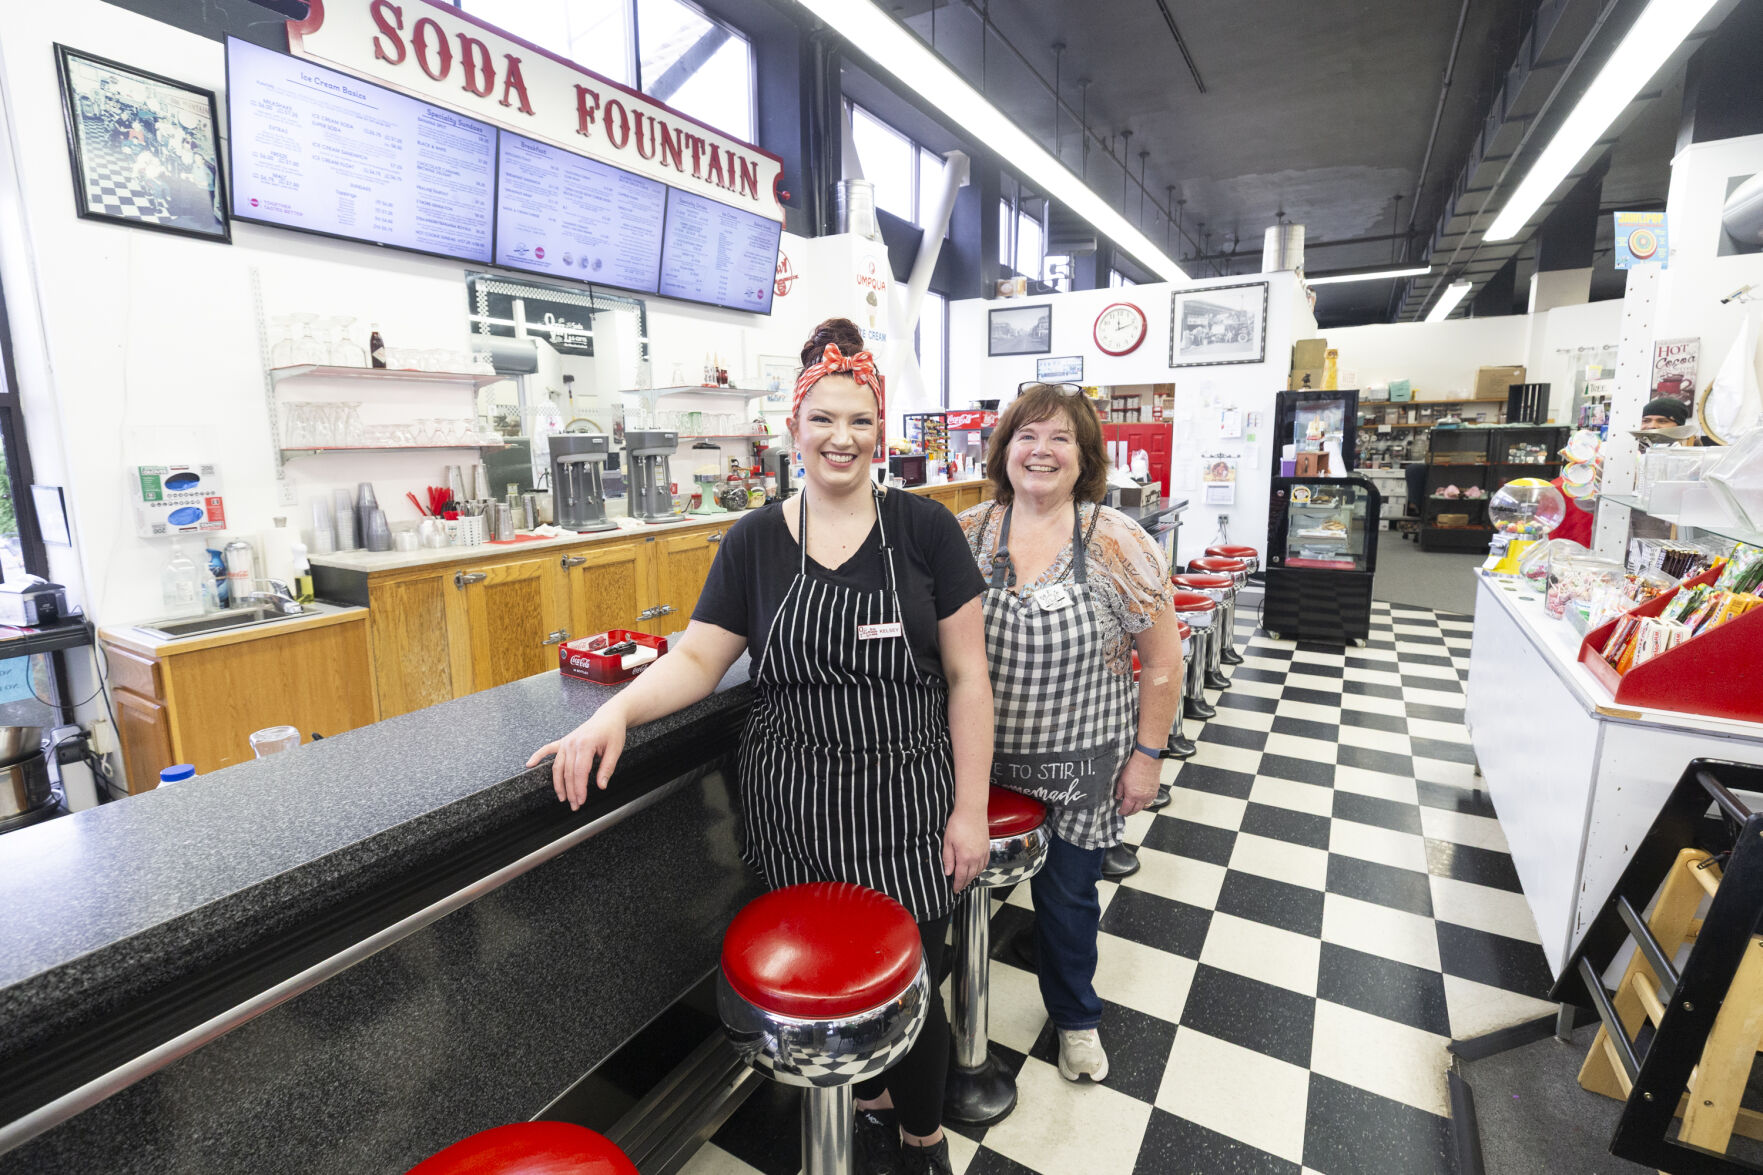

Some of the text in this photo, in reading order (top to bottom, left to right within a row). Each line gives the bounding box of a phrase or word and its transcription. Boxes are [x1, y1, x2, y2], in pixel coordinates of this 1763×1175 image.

[370, 0, 535, 116] SODA
[300, 71, 312, 83] Ice
[314, 76, 339, 92] Cream
[342, 85, 366, 100] Basics
[426, 108, 482, 132] Specialty Sundaes
[520, 141, 546, 155] Breakfast
[573, 83, 759, 201] FOUNTAIN
[857, 274, 886, 291] UMPQUA
[868, 330, 886, 341] CREAM
[1658, 344, 1689, 358] HOT
[1656, 355, 1695, 369] Cocoa
[570, 655, 590, 669] Coca-Cola
[1008, 763, 1032, 779] TO
[1037, 762, 1075, 780] STIR
